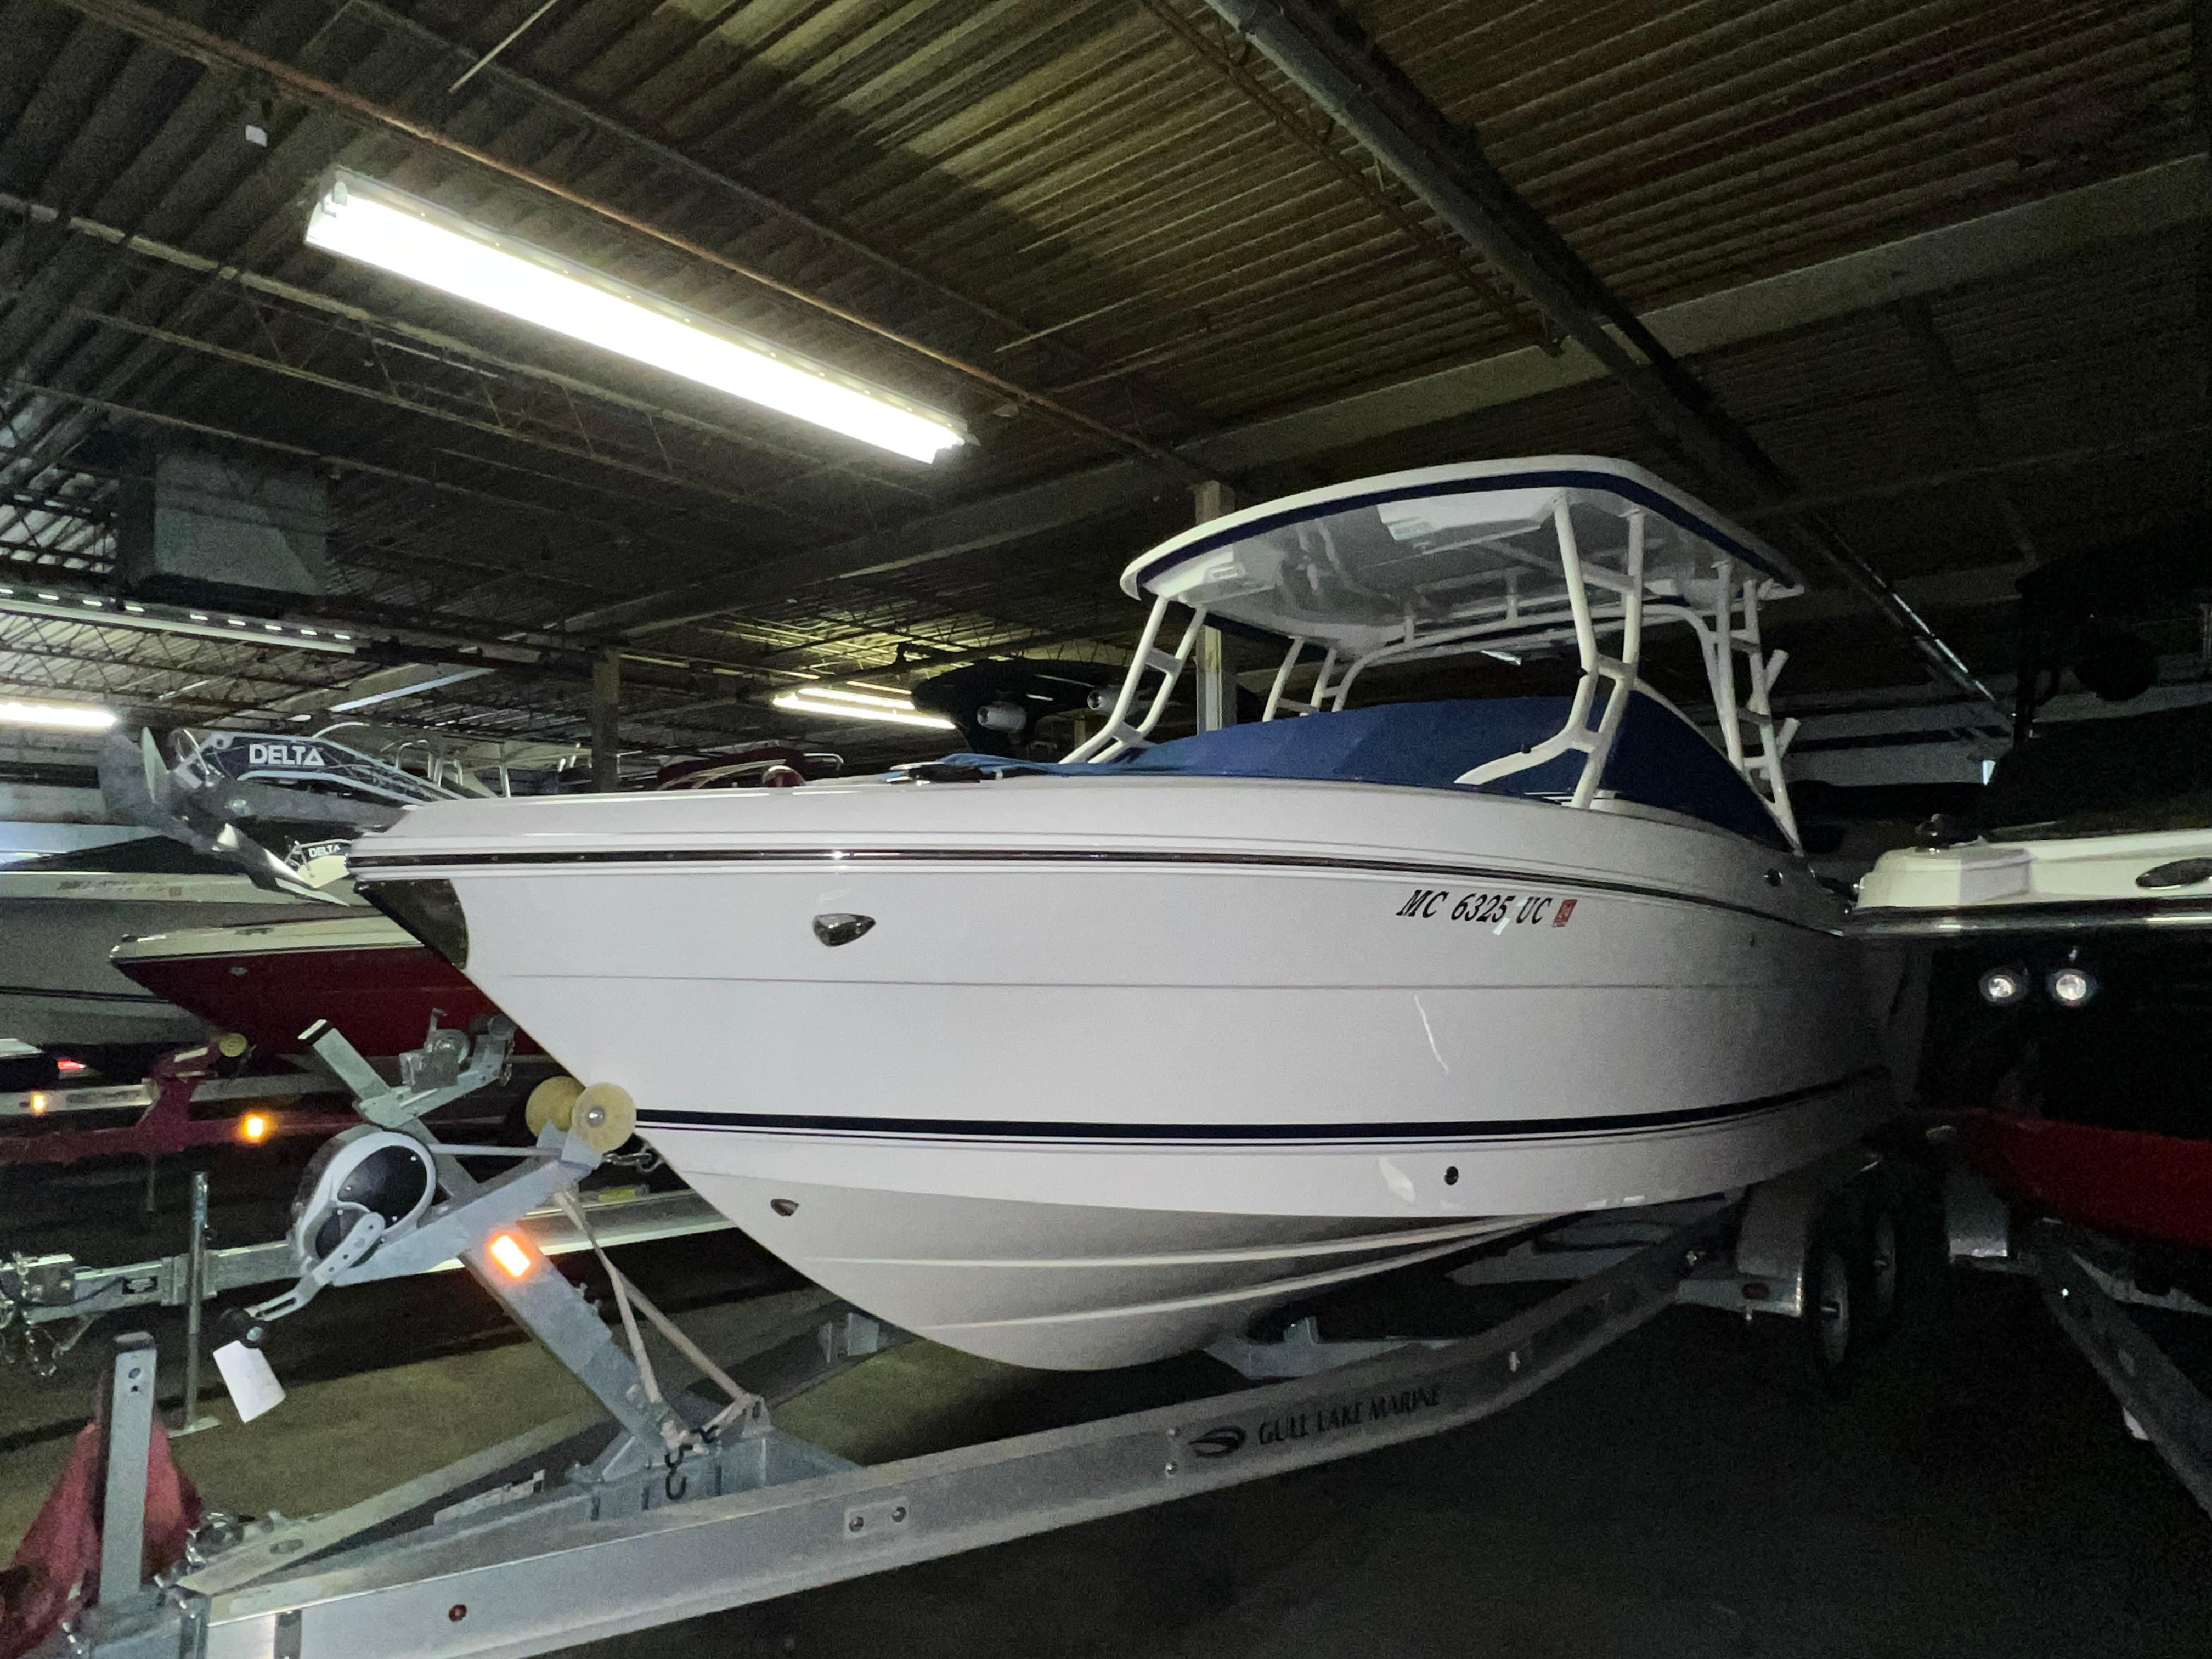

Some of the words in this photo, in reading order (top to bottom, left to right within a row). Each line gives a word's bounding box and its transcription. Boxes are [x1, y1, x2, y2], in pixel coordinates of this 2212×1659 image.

[249, 743, 326, 766] DELTA
[1395, 889, 1449, 919] MC
[1451, 892, 1516, 923] 6325
[1515, 895, 1553, 924] UC
[1258, 1413, 1309, 1446] GULL
[1317, 1401, 1363, 1432] LAKE
